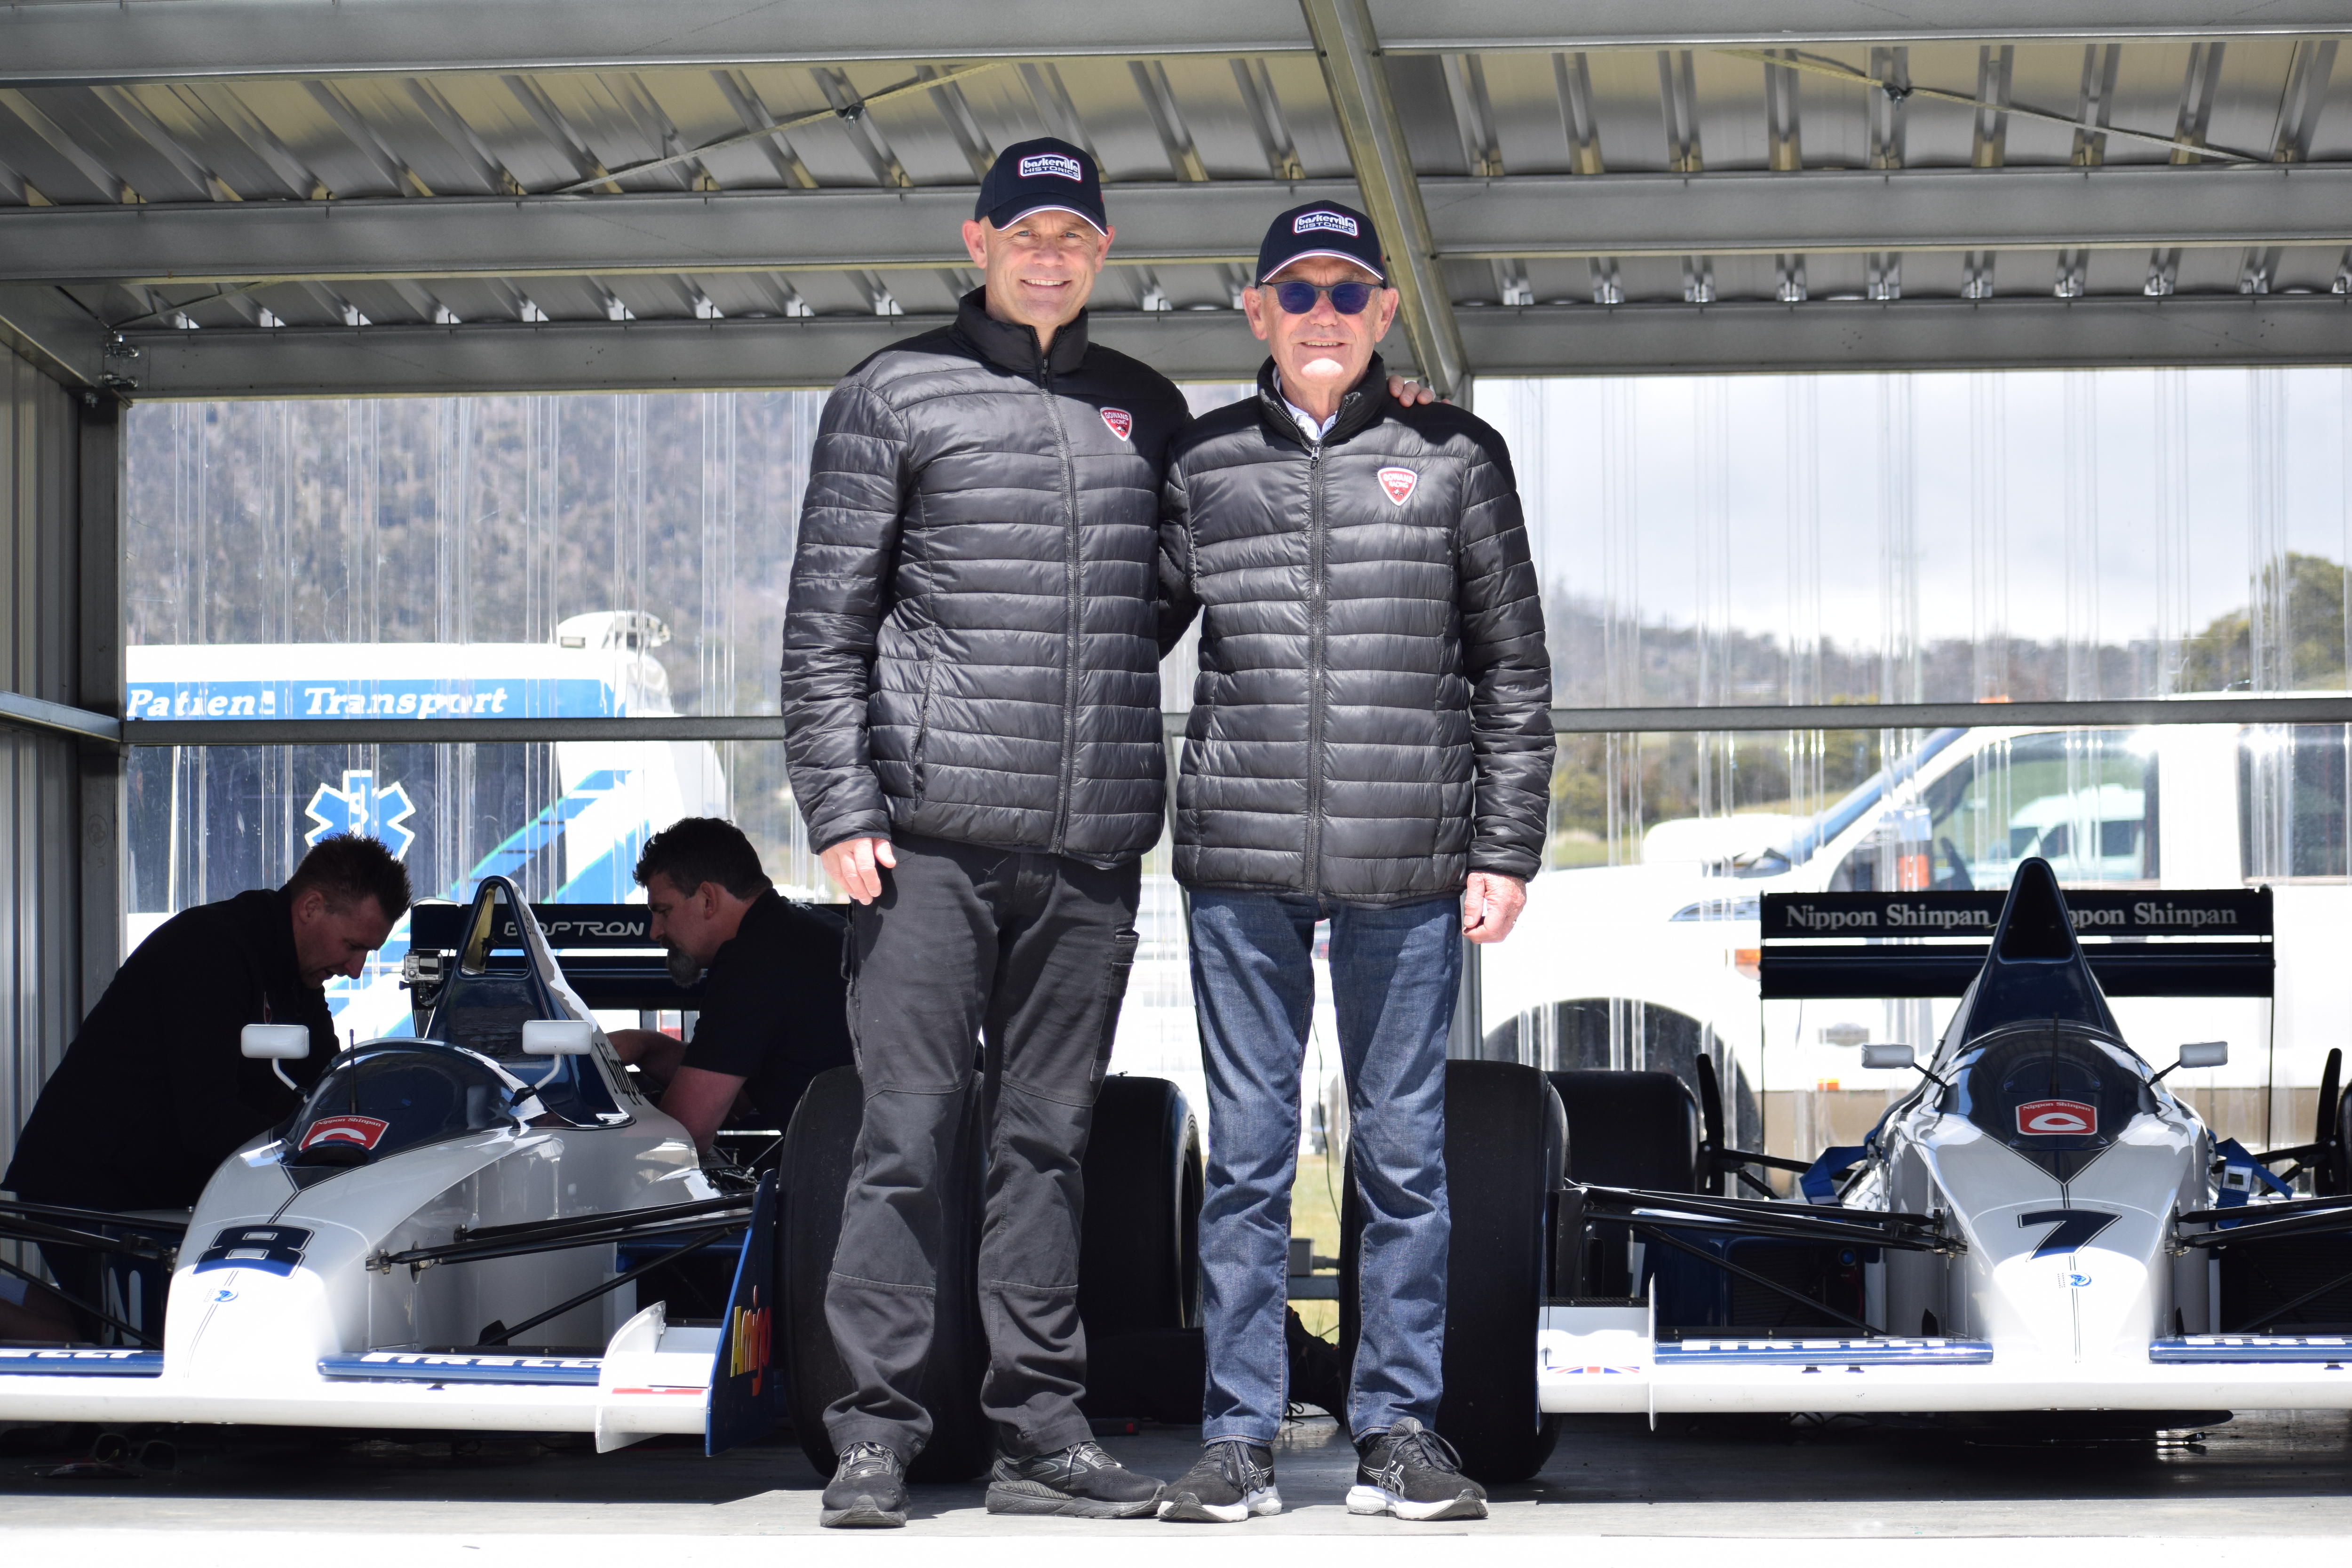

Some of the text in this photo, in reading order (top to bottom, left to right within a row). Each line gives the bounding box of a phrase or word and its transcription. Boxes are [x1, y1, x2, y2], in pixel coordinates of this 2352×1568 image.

[1024, 158, 1079, 172] baskerville
[1025, 166, 1079, 177] HISTORICS
[1298, 215, 1355, 228] baskerville
[1298, 222, 1354, 233] HISTORICS
[1104, 412, 1129, 421] GOWANS
[304, 687, 508, 719] Transport
[1786, 901, 2238, 930] Nippon Shinpan ppon Shinpan
[504, 922, 644, 936] BOPTRON
[2023, 1101, 2091, 1112] Nippon Shinpan
[348, 1117, 381, 1127] Shinpan
[2018, 1208, 2122, 1262] 7
[189, 1224, 315, 1279] 8
[730, 1284, 772, 1397] Amigo
[360, 1352, 605, 1369] PIRELL
